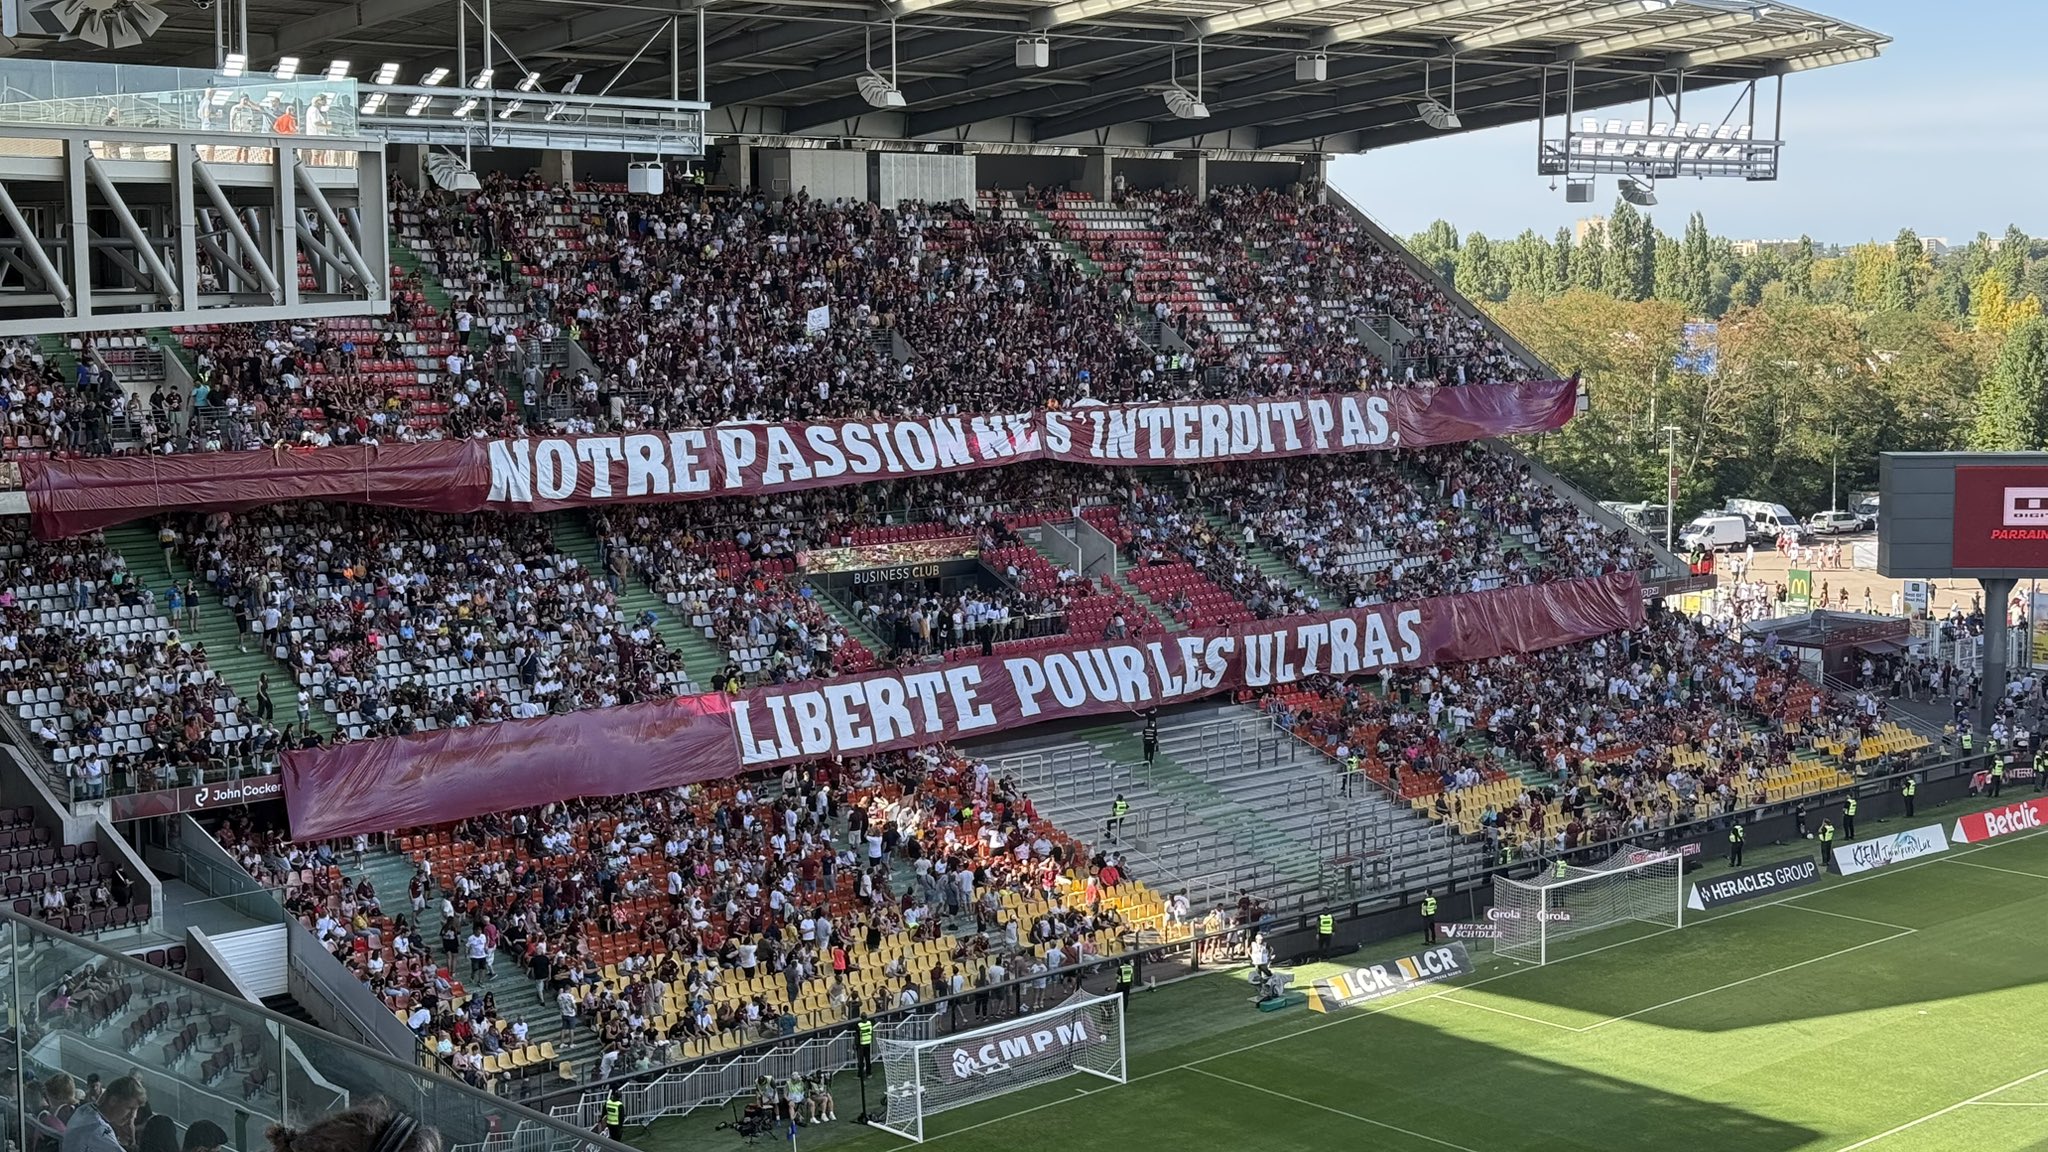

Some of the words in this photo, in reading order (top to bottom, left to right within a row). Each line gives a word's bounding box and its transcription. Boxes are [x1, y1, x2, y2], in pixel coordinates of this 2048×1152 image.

[486, 430, 710, 502] NOTRE
[717, 416, 974, 489] PASSION
[970, 410, 1042, 461] NE
[1046, 400, 1303, 459] S'INTERDIT
[1307, 396, 1400, 448] PAS,
[853, 567, 910, 585] BUSINESS
[912, 564, 940, 578] CLUB
[1641, 586, 1659, 599] ppa
[731, 664, 997, 766] LIBERTE
[1004, 645, 1152, 718] POUR
[1147, 636, 1235, 698] LES
[1244, 609, 1422, 688] ULTRAS
[213, 787, 241, 801] John
[243, 783, 283, 796] Cocker
[1984, 801, 2041, 838] Betclic
[1710, 871, 1775, 900] HERACLES
[1775, 861, 1815, 884] GROUP
[1486, 907, 1521, 921] Carola
[1411, 947, 1459, 978] LCR
[1344, 964, 1395, 997] LCR
[978, 1021, 1087, 1065] CMPM
